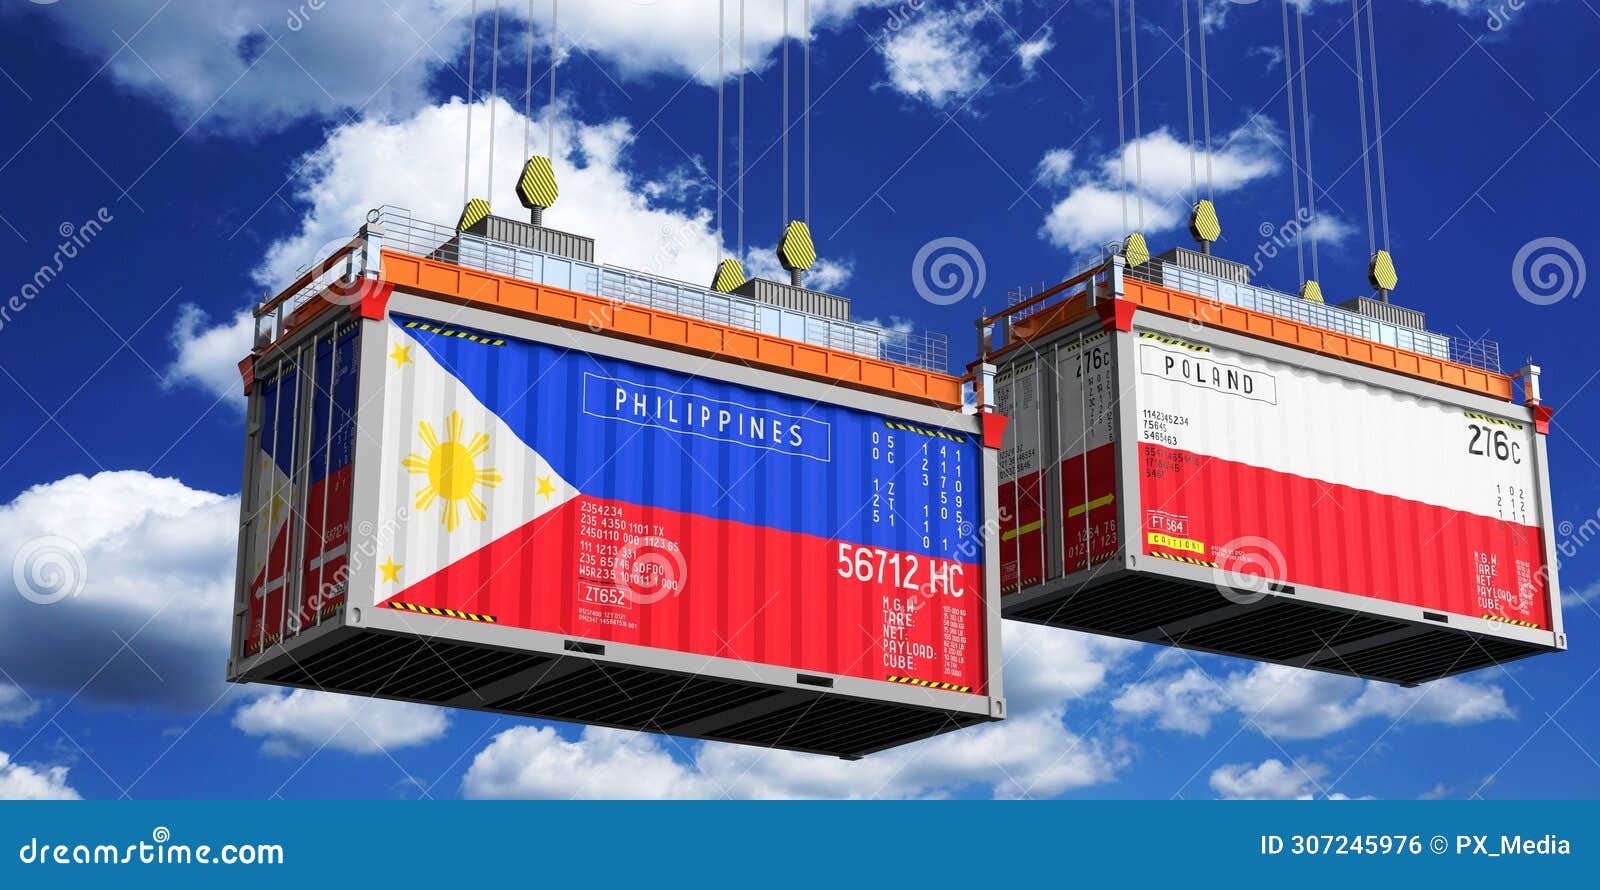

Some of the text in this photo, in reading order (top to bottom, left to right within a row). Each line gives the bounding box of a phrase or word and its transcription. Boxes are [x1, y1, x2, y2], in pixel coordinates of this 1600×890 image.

[1165, 355, 1254, 394] POLAND
[616, 388, 802, 447] PHILIPPINES
[581, 501, 622, 517] 2354234
[581, 513, 664, 537] 235 4350 1101 TX
[1152, 516, 1184, 532] FT 564
[580, 540, 592, 552] 111
[596, 544, 618, 556] 1213
[580, 552, 596, 566] 235
[838, 543, 919, 590] 56712
[930, 560, 964, 598] HC
[586, 586, 625, 606] ZT652
[883, 624, 908, 640] NET:
[884, 638, 936, 660] PAYLOAD:
[884, 652, 916, 670] CUBE:
